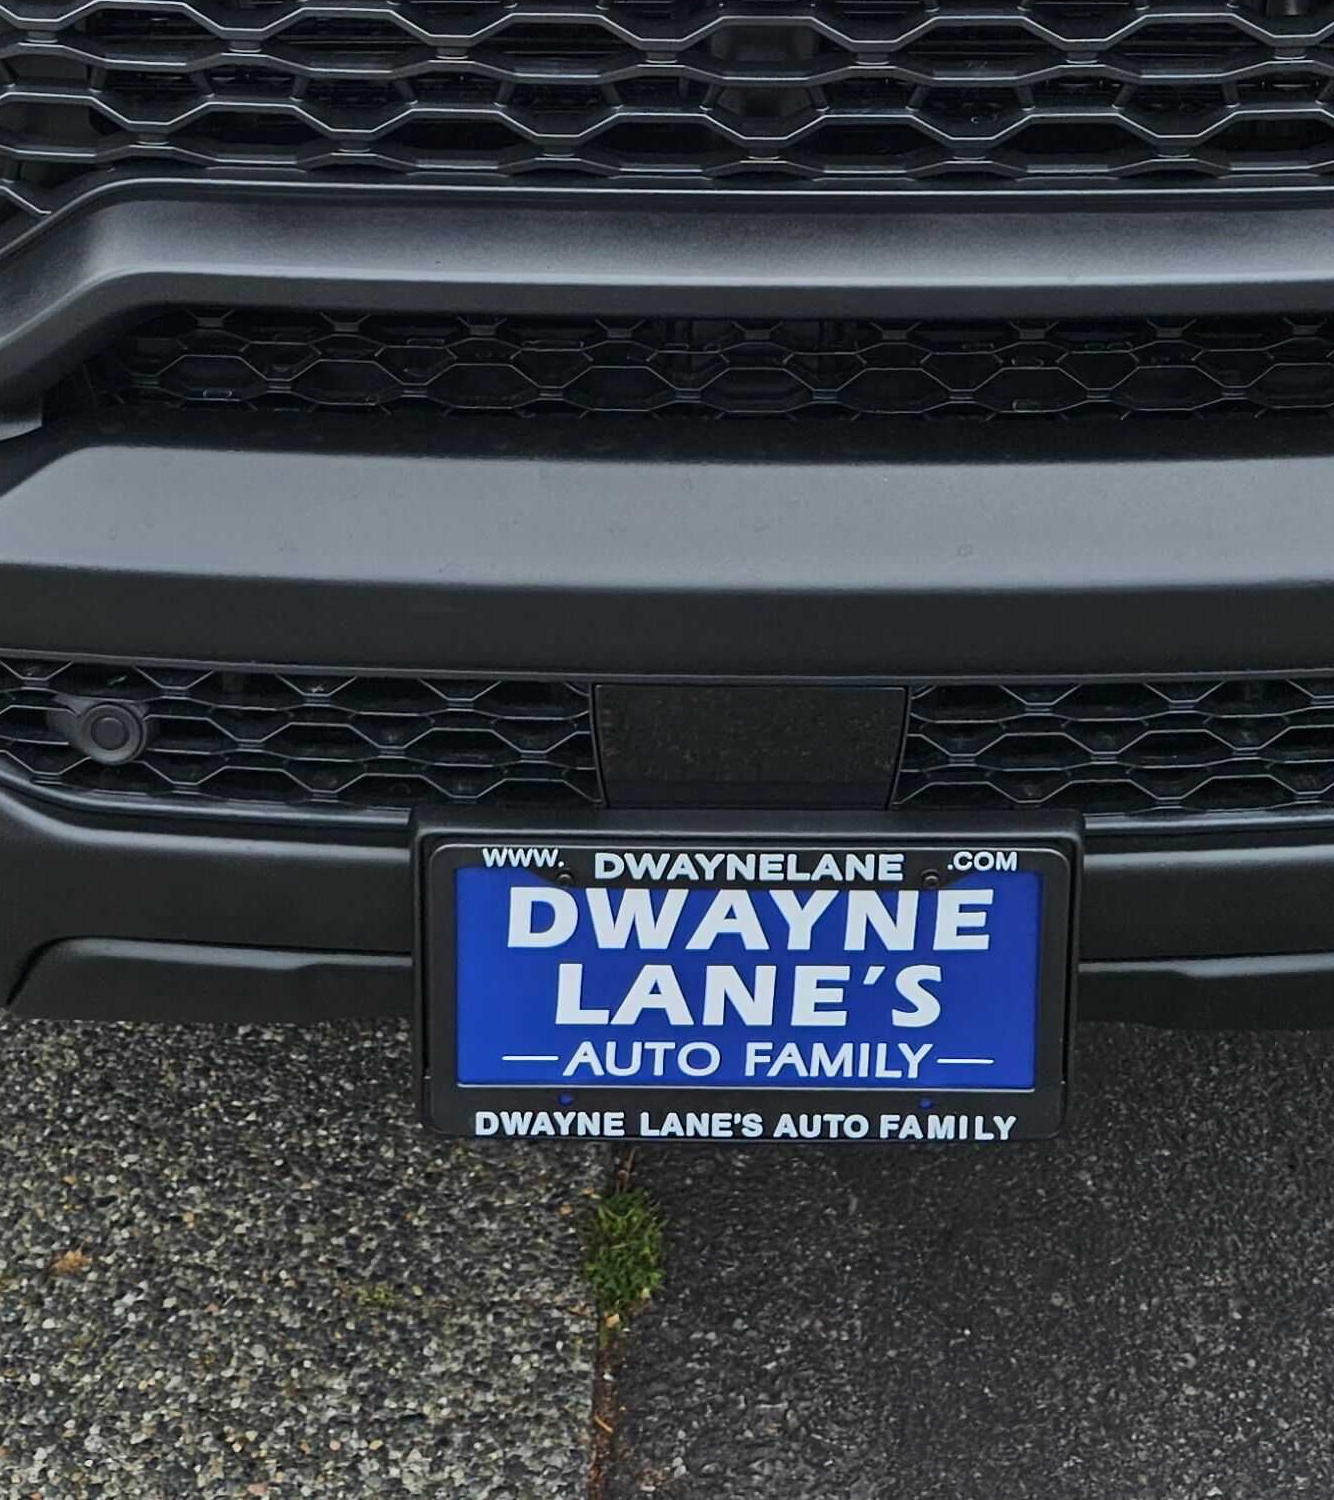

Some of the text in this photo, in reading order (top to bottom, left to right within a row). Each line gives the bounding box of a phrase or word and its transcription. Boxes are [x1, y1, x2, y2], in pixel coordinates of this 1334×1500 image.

[593, 851, 905, 882] DWAYNELANE
[946, 850, 1019, 873] .COM
[507, 886, 994, 951] DWAYNE
[555, 963, 943, 1027] LANE'S
[562, 1041, 934, 1079] AUTO FAMILY
[474, 1111, 1017, 1141] DWAYNE LANE'S AUTO FAMILY
